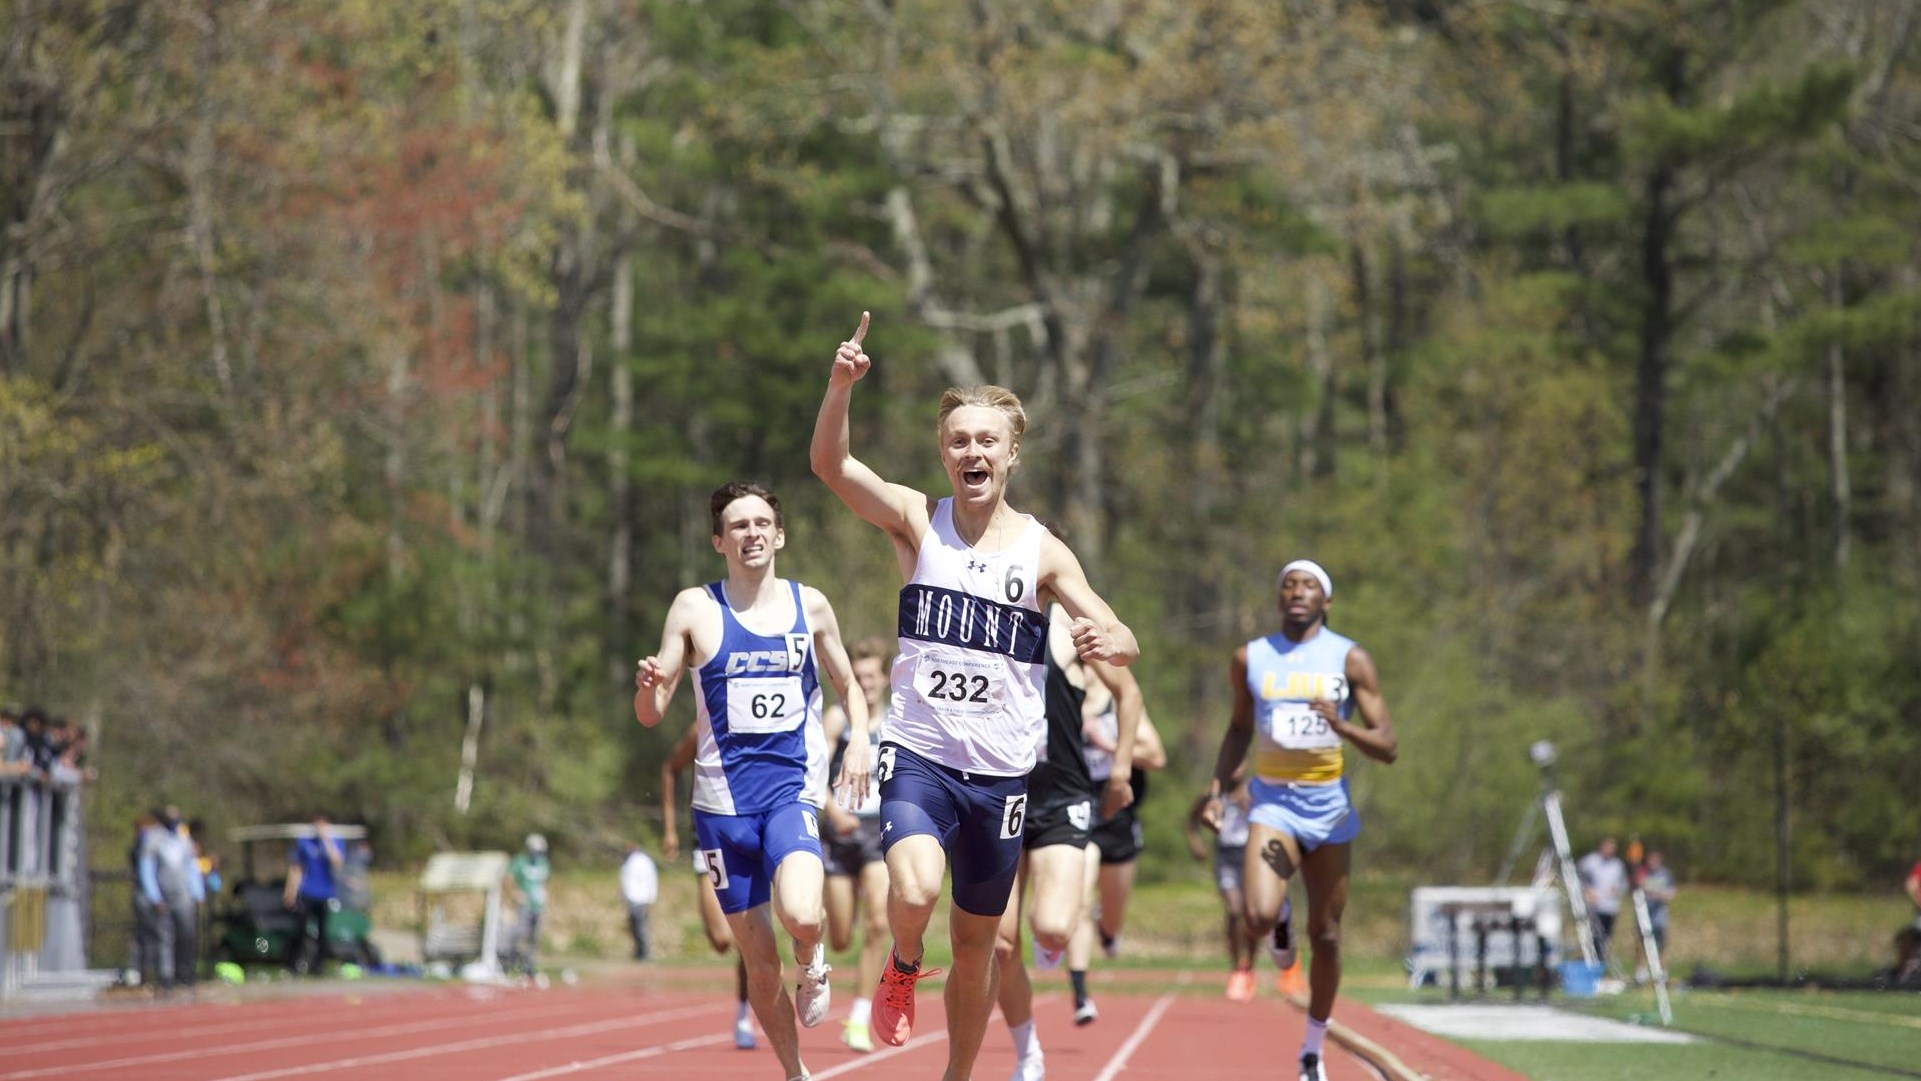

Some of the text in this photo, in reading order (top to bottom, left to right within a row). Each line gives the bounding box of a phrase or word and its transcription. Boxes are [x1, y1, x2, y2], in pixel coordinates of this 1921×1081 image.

[1005, 565, 1024, 603] 6
[915, 589, 1024, 655] MOUNT
[792, 637, 804, 670] 5
[928, 670, 989, 703] 232
[751, 693, 785, 719] 62
[1288, 715, 1328, 735] 125
[1008, 797, 1024, 836] 6
[707, 853, 721, 887] 5
